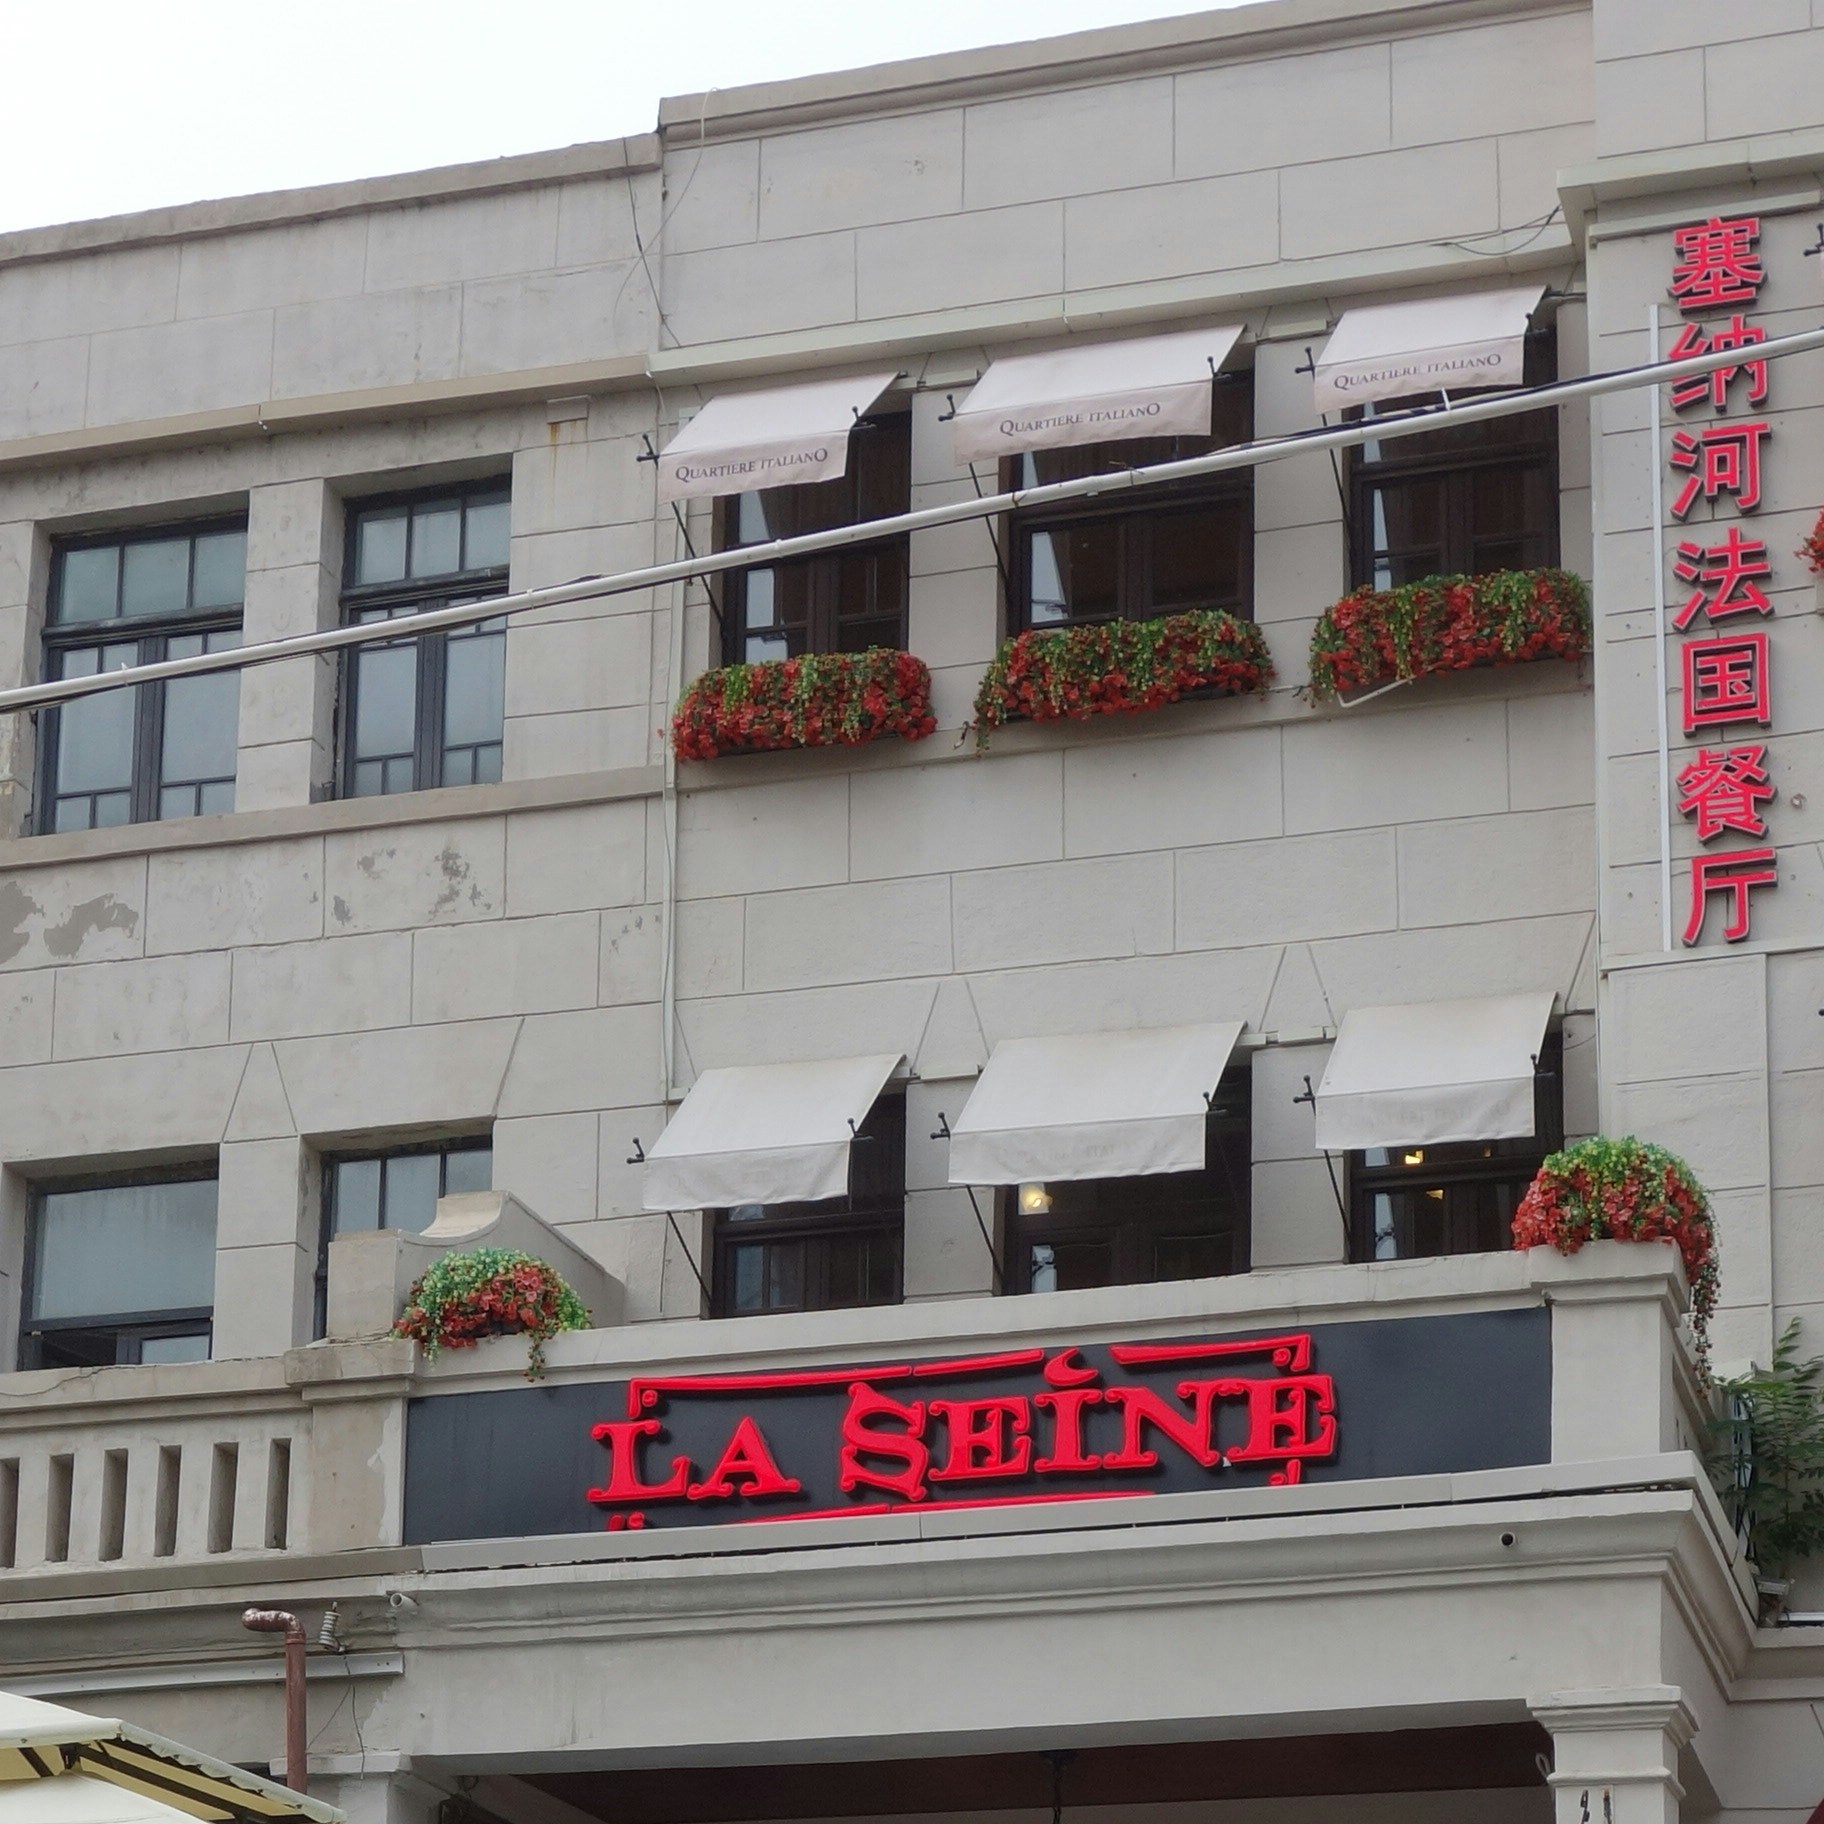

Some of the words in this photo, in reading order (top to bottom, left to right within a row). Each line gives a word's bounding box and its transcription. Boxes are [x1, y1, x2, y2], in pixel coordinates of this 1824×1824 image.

[1667, 216, 1777, 946] 塞纳河法国餐厅
[587, 1416, 802, 1502] LA
[839, 1349, 1338, 1502] SEINE
